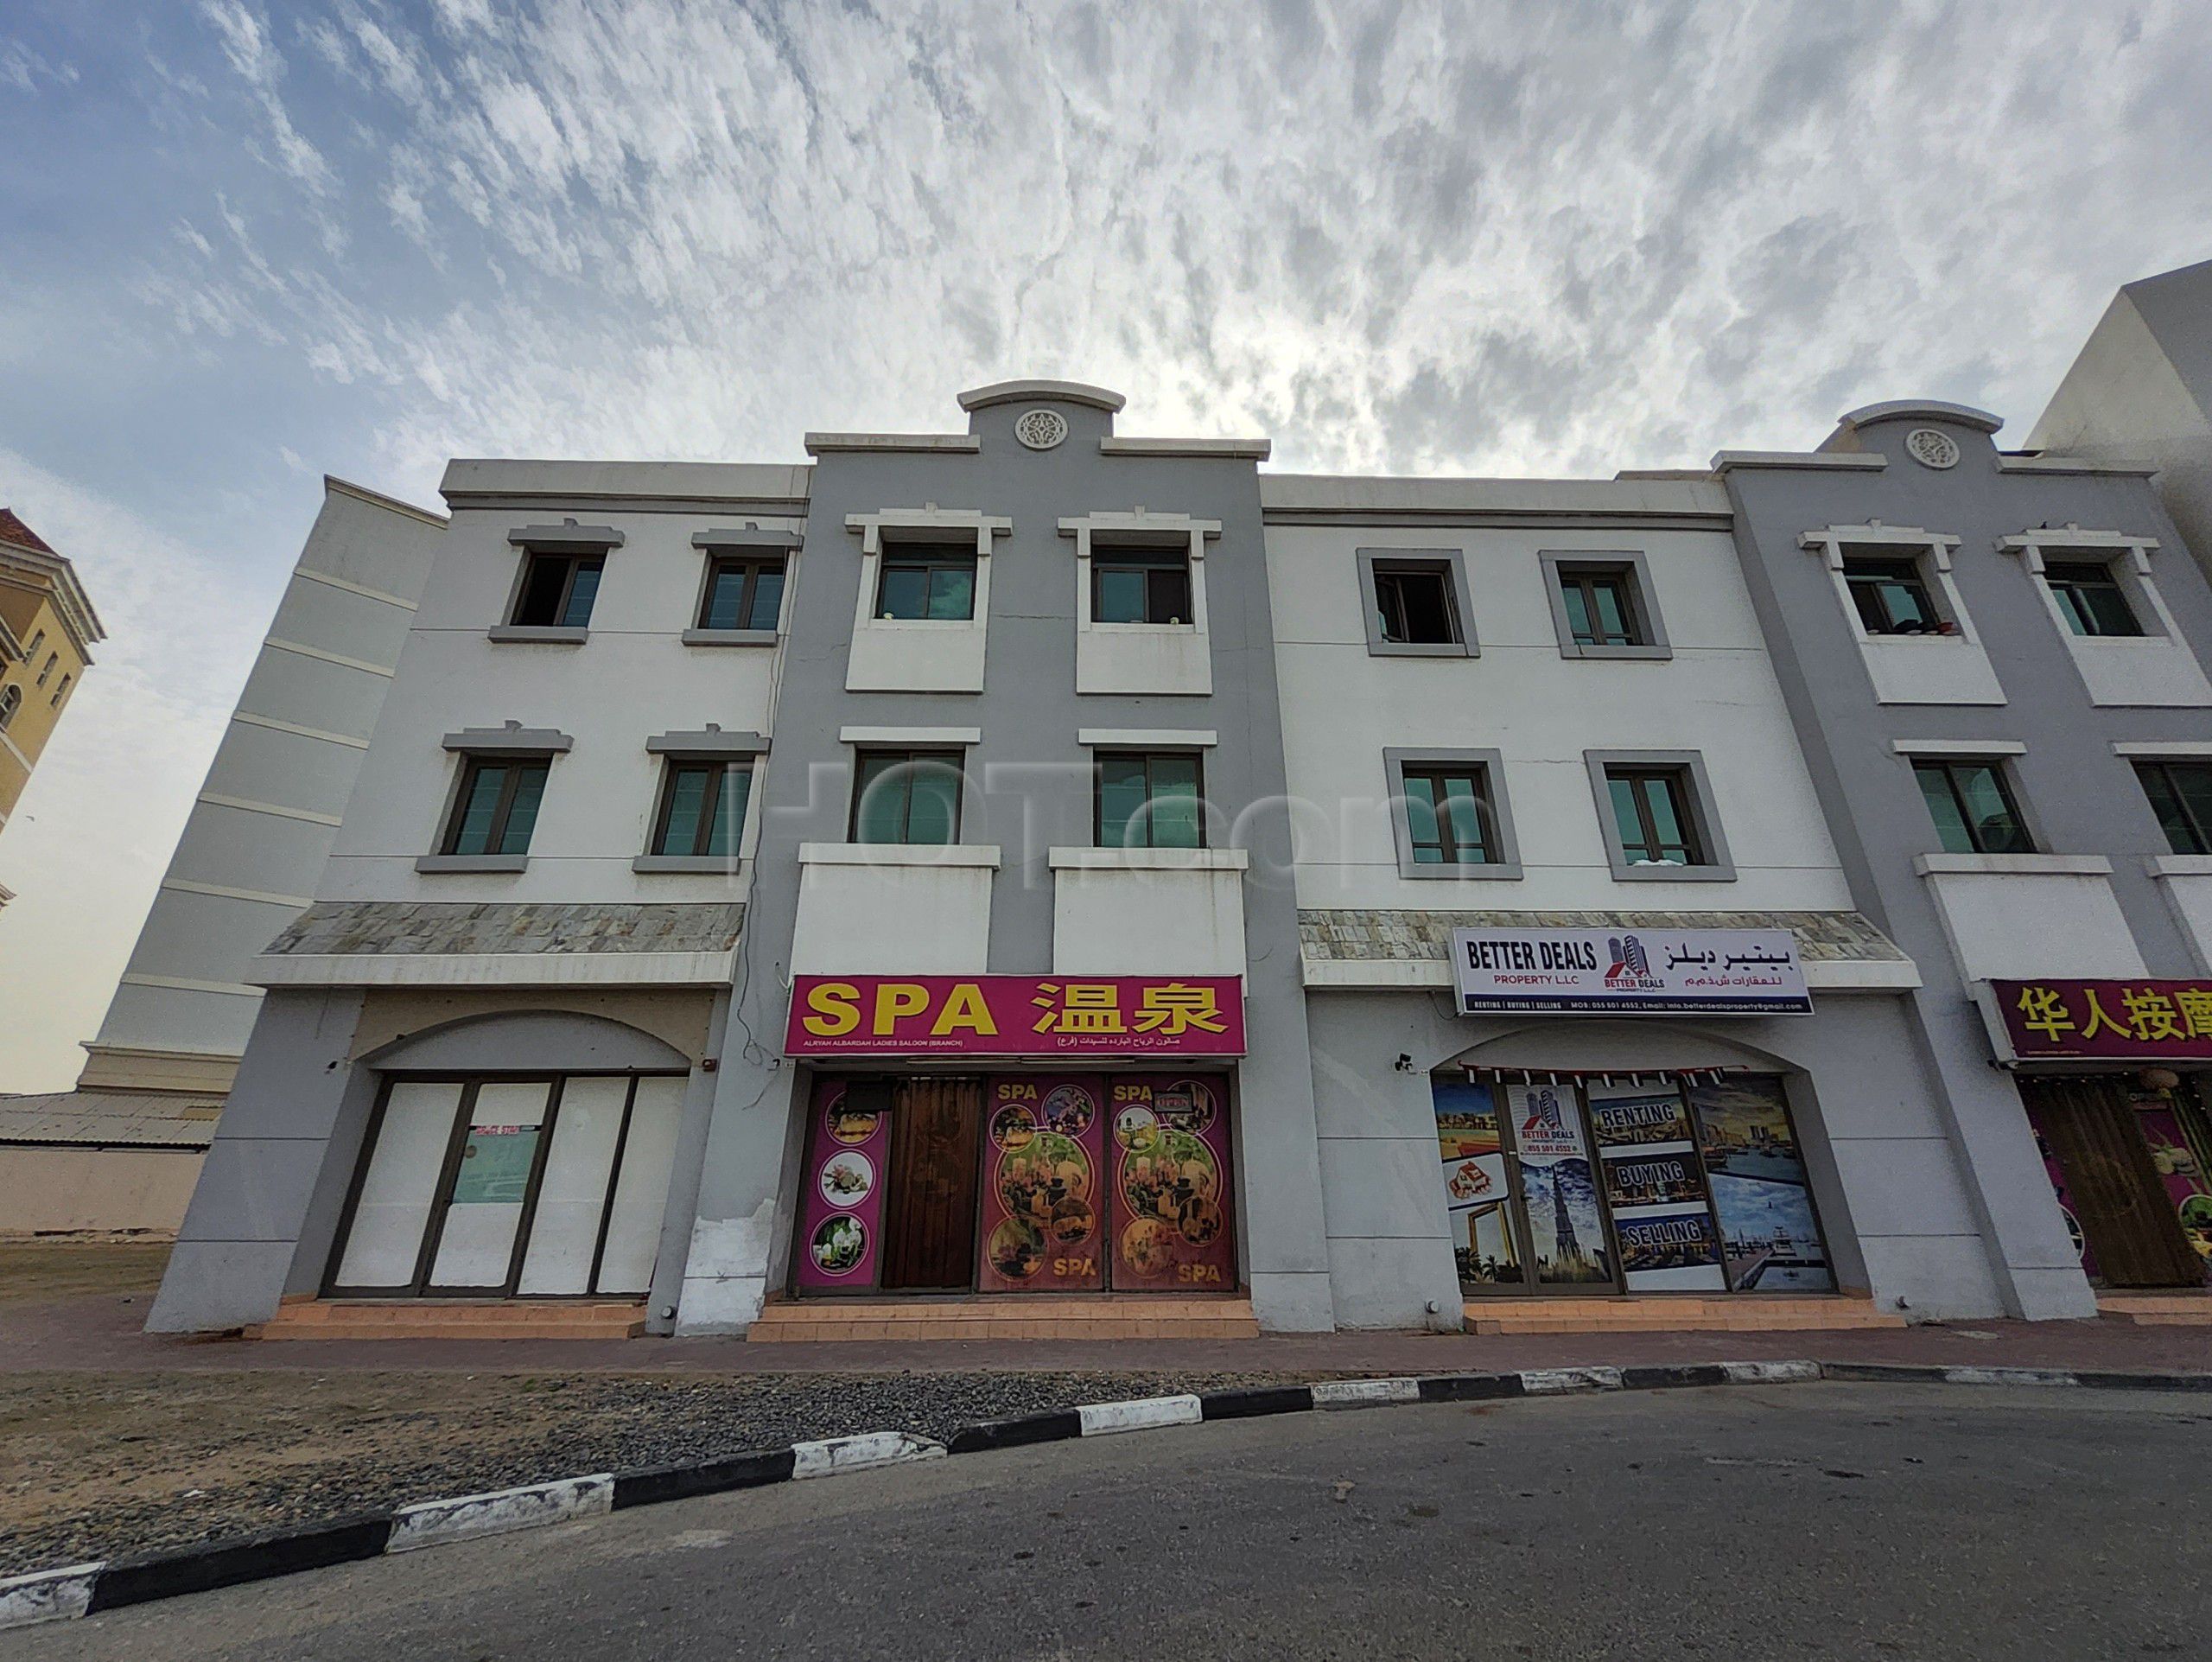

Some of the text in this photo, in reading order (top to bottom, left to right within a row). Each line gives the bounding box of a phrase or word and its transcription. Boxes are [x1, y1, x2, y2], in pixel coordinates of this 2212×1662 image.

[1466, 940, 1598, 971] BETTER DEALS
[1664, 942, 1794, 971] بيتير ديلز
[1494, 975, 1552, 984] PROPERTY
[1605, 978, 1665, 988] BETTER DEALS
[1732, 976, 1783, 987] للعقارات
[802, 983, 998, 1036] SPA
[1030, 982, 1228, 1036] 温泉
[1474, 1001, 1501, 1009] RENTING
[1507, 1001, 1530, 1009] BUYING
[1536, 1001, 1562, 1009] SELLING
[928, 1040, 963, 1048] (BRANCH)
[997, 1083, 1038, 1102] SPA
[1113, 1085, 1154, 1102] SPA
[1599, 1103, 1677, 1129] RENTING
[1522, 1130, 1575, 1139] BETTER DEALS
[1617, 1161, 1686, 1188] BUYING
[1625, 1219, 1701, 1247] SELLING
[1052, 1257, 1097, 1277] SPA
[1177, 1264, 1223, 1284] SPA
